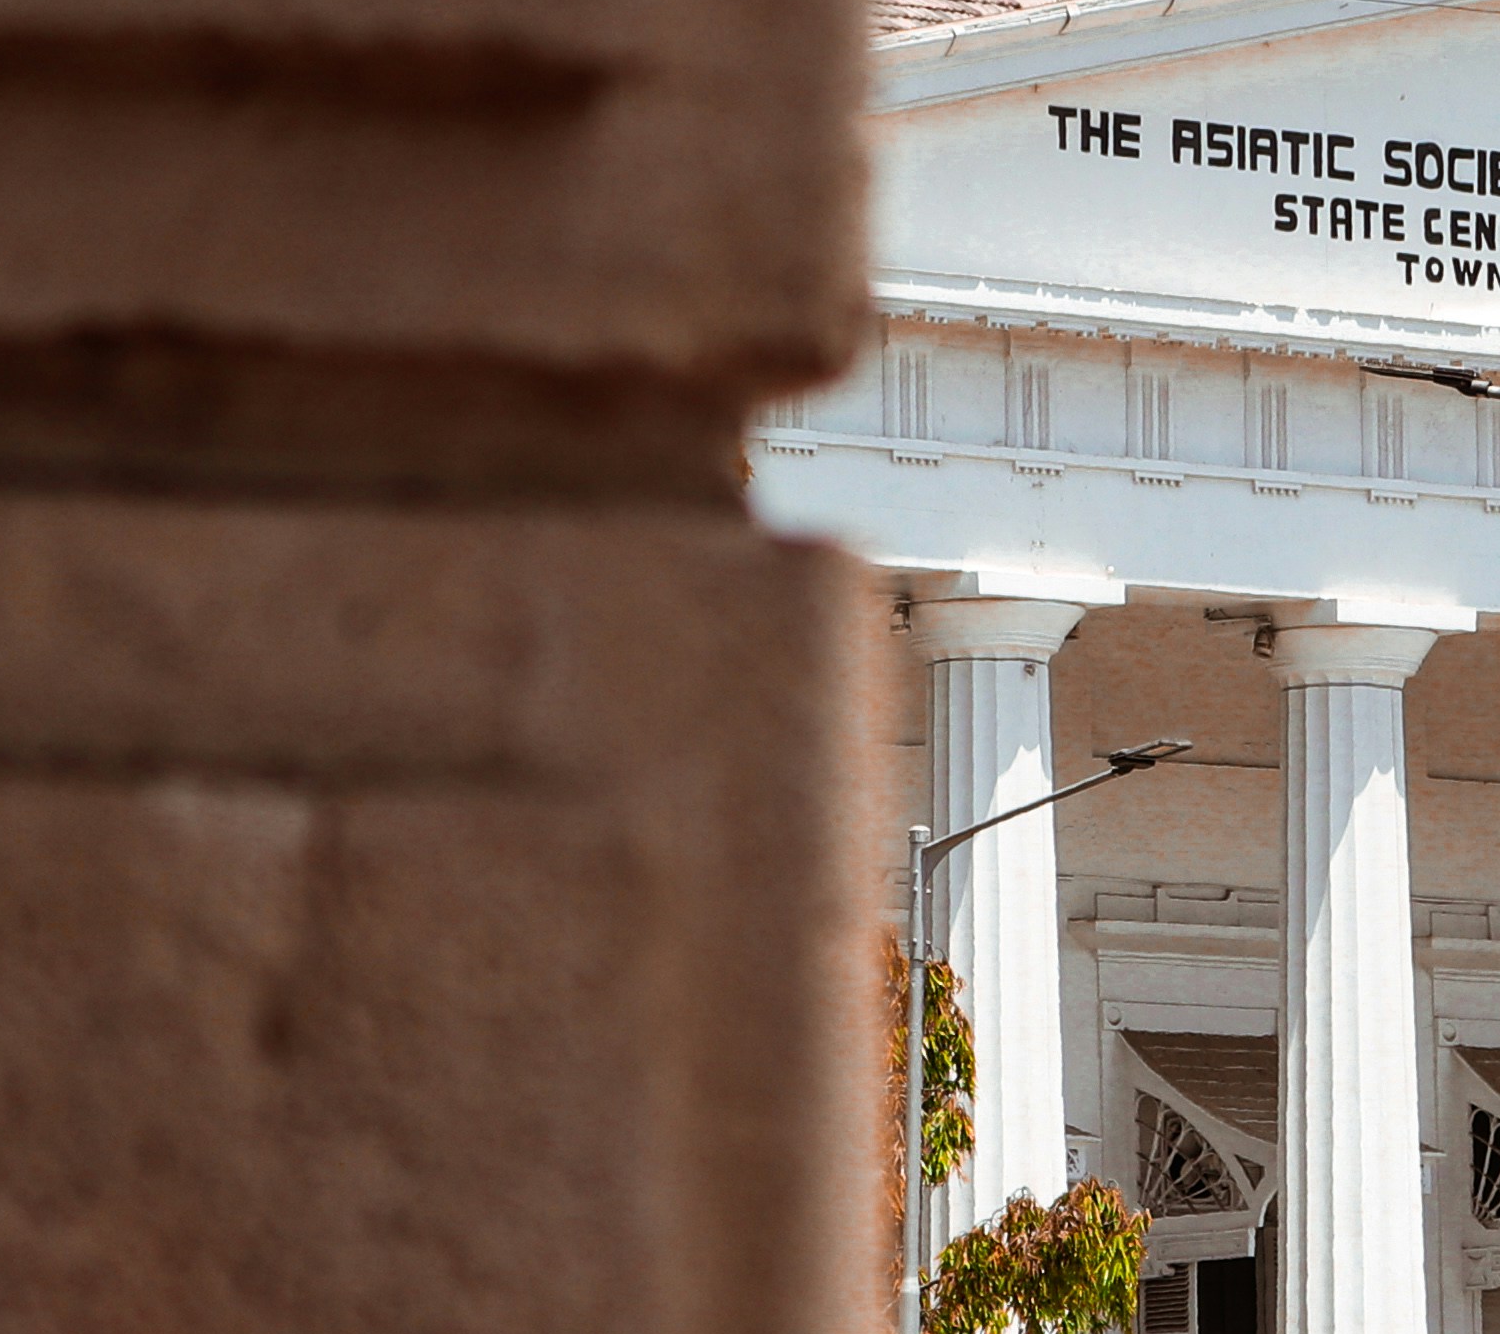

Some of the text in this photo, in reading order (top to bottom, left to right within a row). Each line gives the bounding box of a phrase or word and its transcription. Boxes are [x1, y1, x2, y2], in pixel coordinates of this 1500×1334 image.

[1047, 105, 1142, 159] THE
[1172, 118, 1355, 182] ASIATIC
[1274, 193, 1406, 242] STATE
